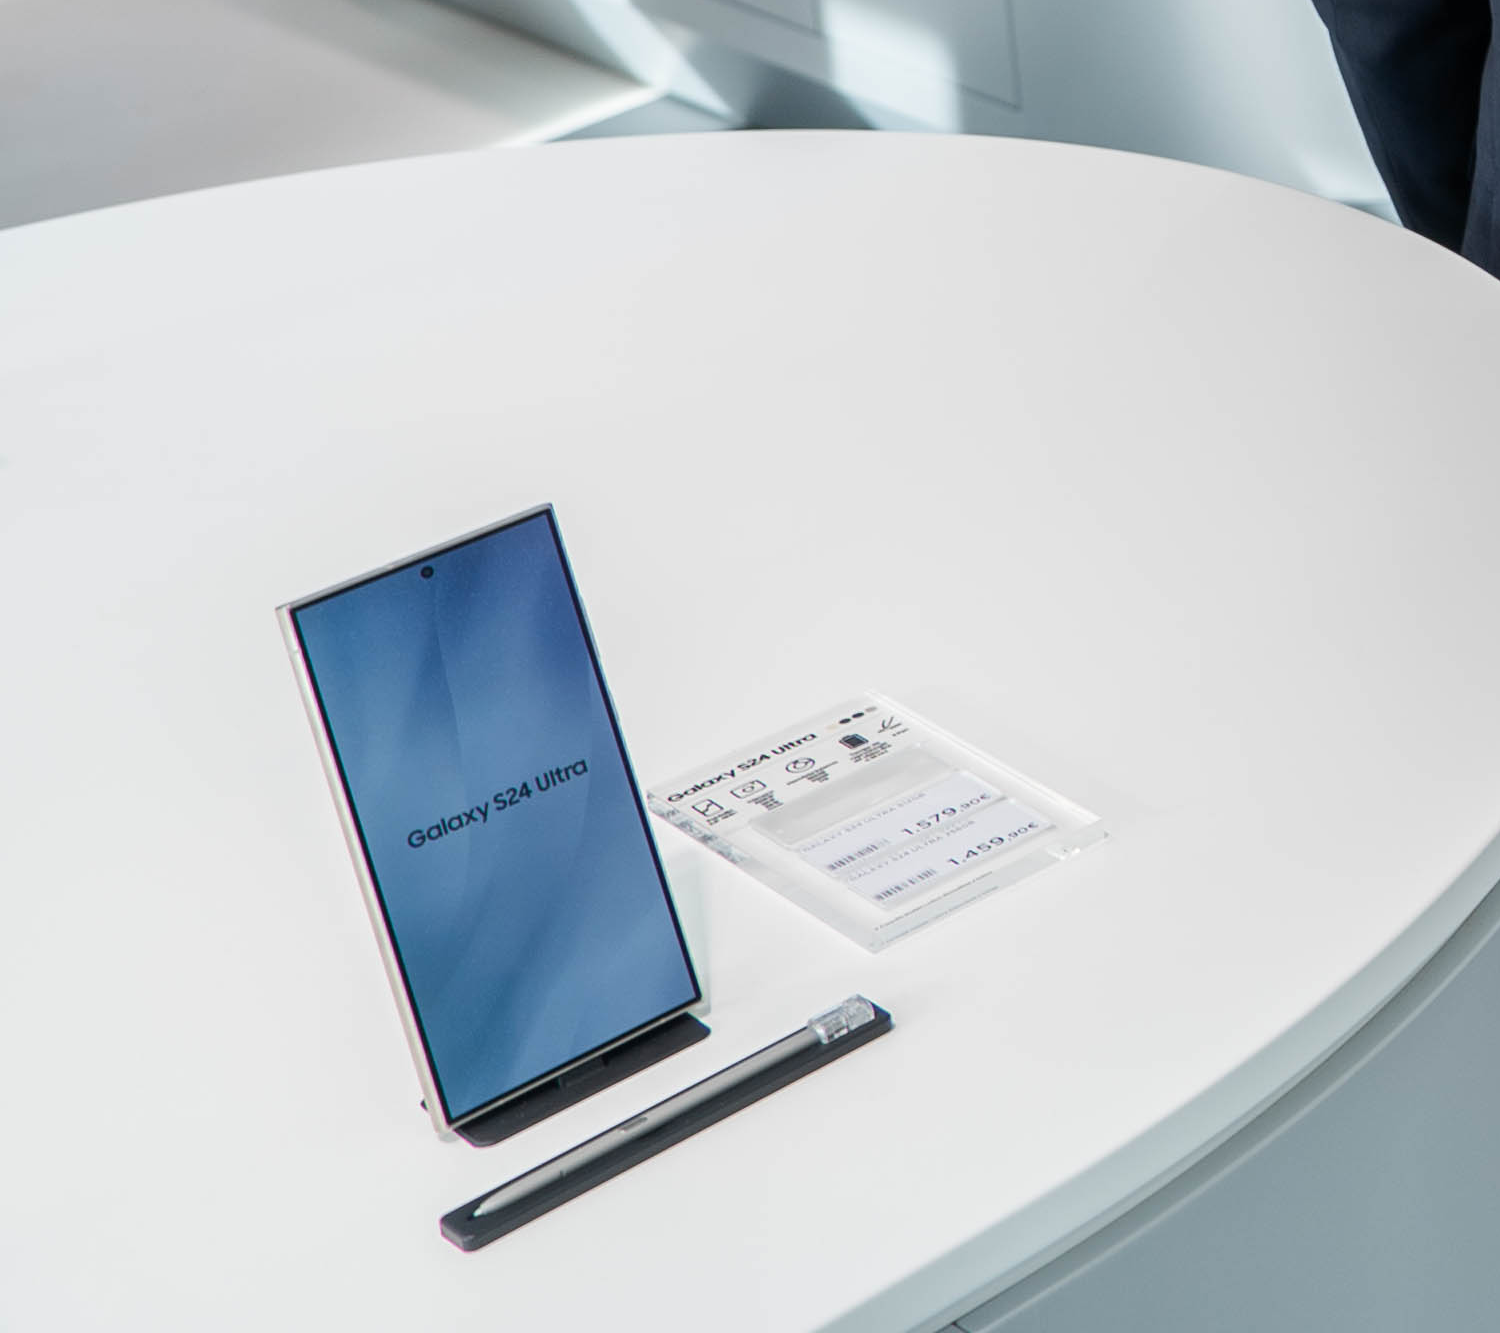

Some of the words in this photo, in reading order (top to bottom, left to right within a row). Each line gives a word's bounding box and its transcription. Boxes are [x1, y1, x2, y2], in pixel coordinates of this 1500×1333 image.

[407, 802, 489, 848] Galaxy
[493, 781, 532, 811] S24
[535, 759, 588, 792] Ultra
[667, 769, 735, 802] Galaxy
[737, 754, 770, 771] S24
[771, 733, 817, 755] Ultra
